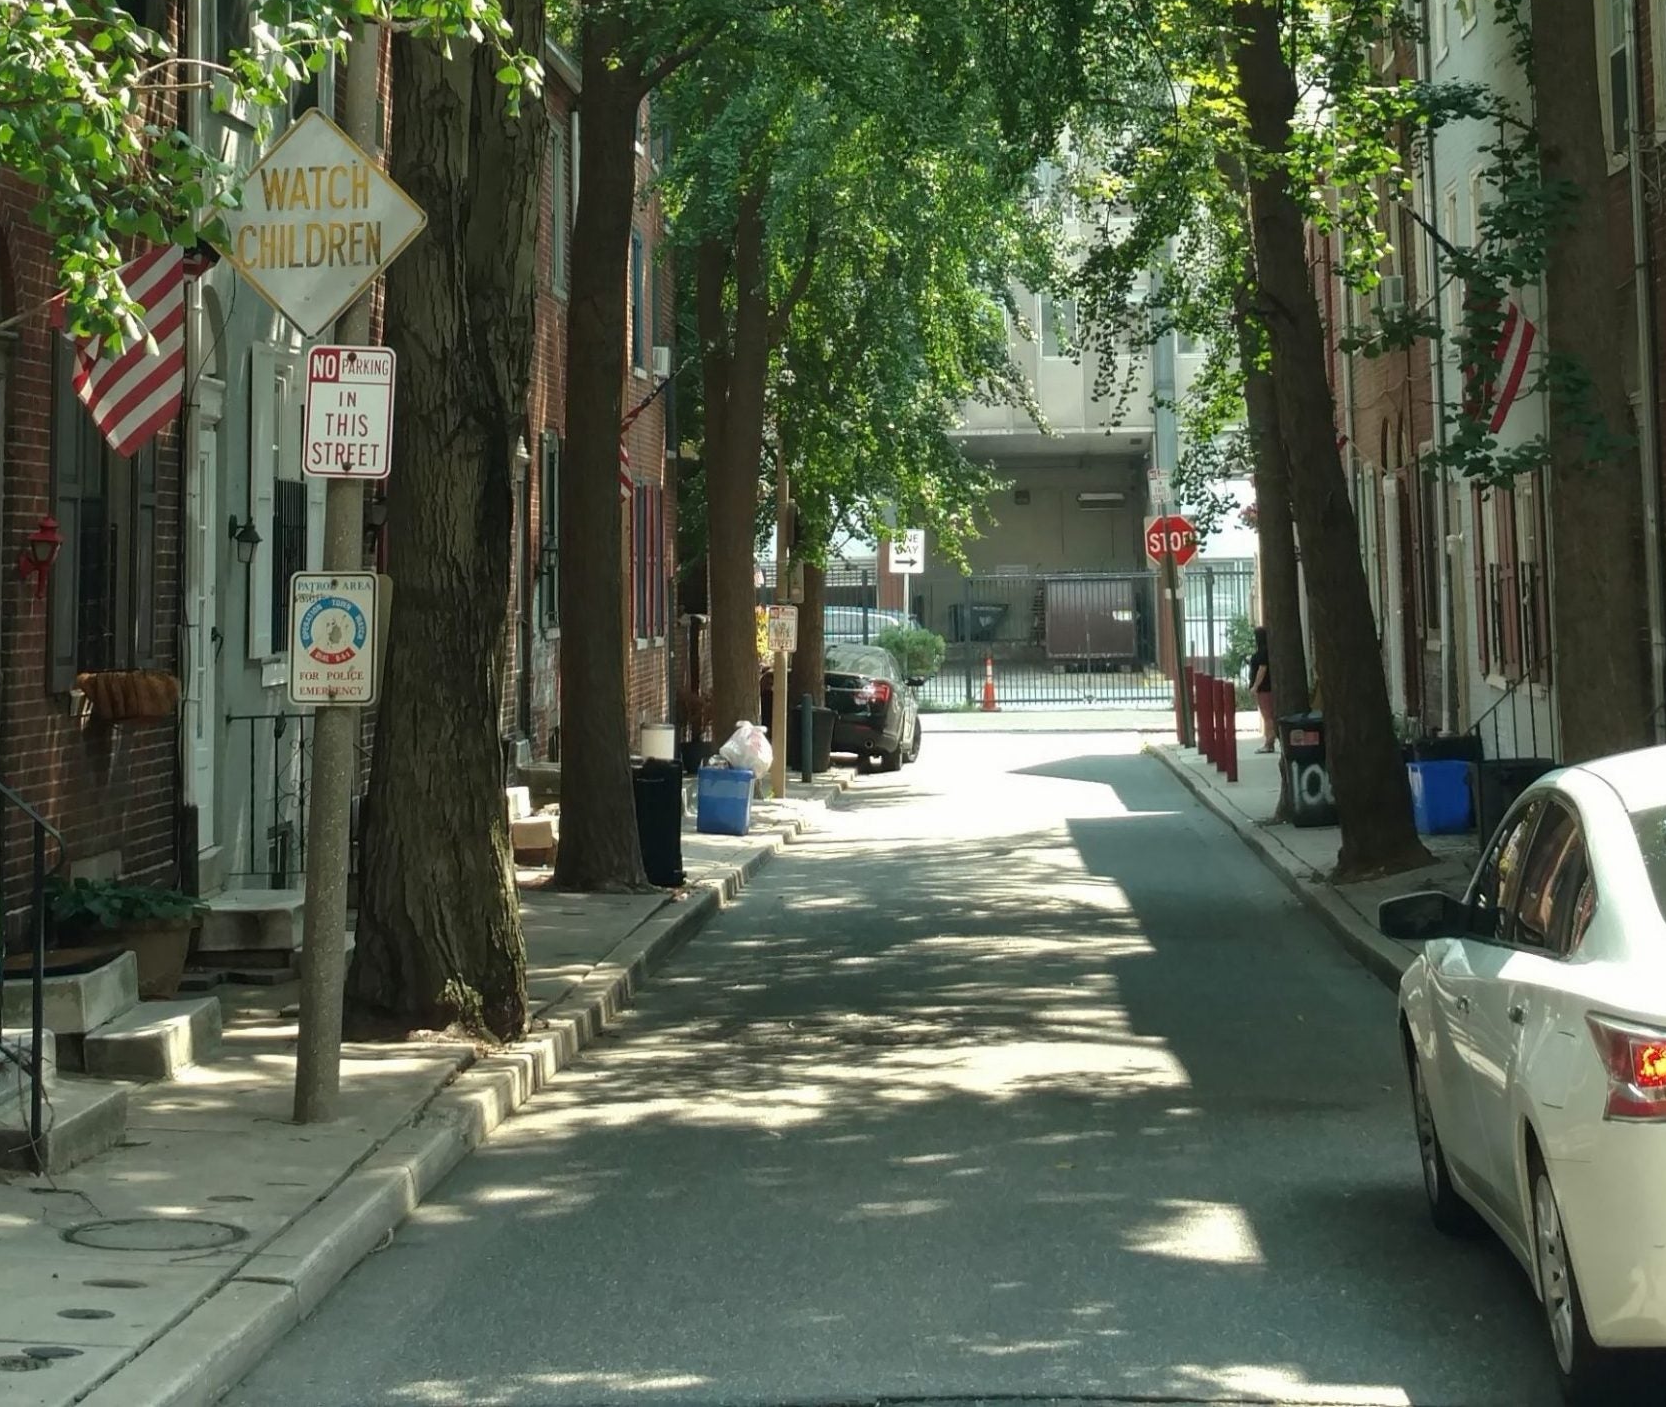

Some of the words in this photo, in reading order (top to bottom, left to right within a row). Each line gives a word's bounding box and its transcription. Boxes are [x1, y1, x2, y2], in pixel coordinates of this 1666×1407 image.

[260, 164, 369, 211] WATCH
[237, 221, 381, 269] CHILDREN
[313, 354, 337, 378] NO
[342, 358, 389, 376] PARKING
[339, 391, 356, 407] IN
[325, 413, 368, 437] THIS
[312, 441, 379, 466] STREET
[342, 581, 371, 591] AREA
[299, 671, 319, 681] FOR
[326, 671, 364, 681] POLICE
[1291, 761, 1335, 813] 10
